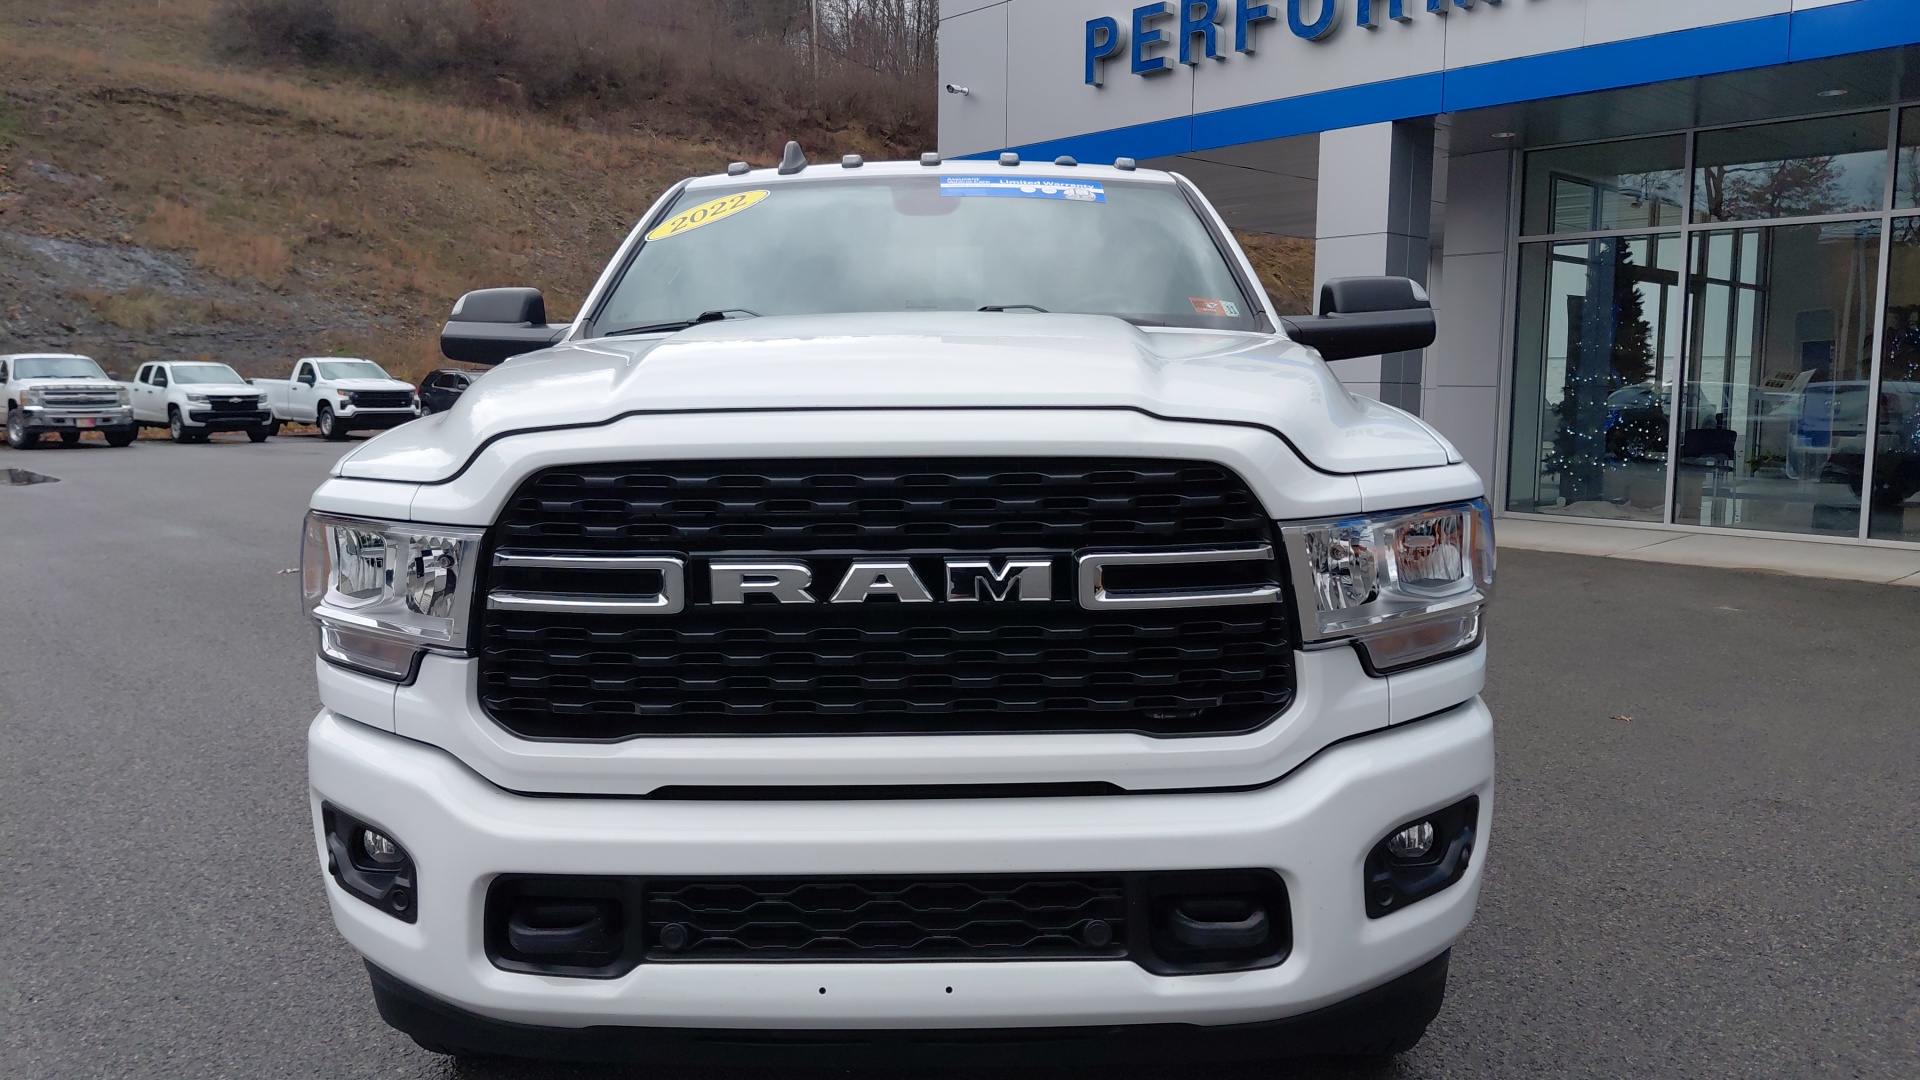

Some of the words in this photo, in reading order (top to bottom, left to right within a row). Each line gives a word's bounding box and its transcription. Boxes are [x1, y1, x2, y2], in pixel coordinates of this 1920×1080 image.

[1085, 0, 1510, 87] PERFO
[1042, 181, 1095, 189] Warranty
[669, 195, 748, 234] 2022
[709, 559, 1053, 605] RAM
